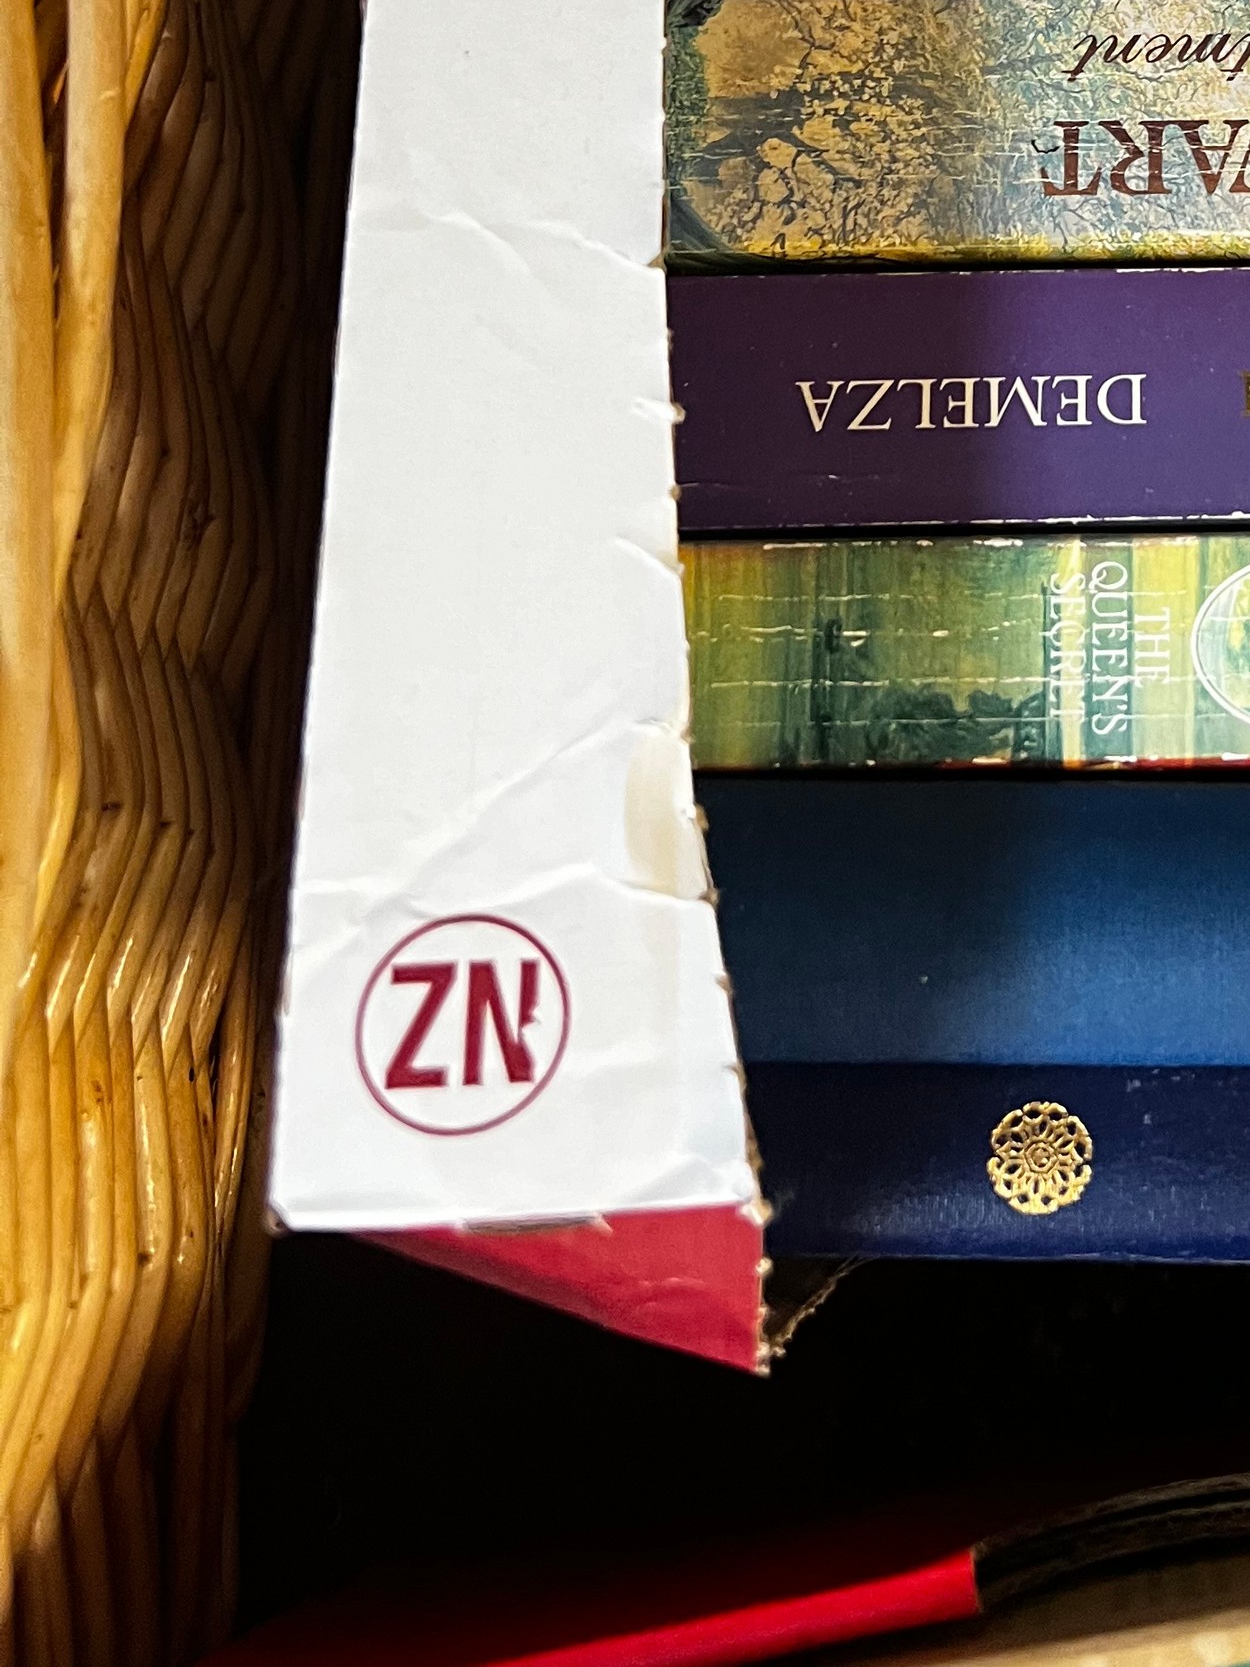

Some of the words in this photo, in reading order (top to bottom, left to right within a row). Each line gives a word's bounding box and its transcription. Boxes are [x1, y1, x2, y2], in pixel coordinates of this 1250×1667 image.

[794, 372, 1150, 434] DEMELZA
[1049, 572, 1088, 725] SECRET
[1088, 560, 1129, 737] QUEEN'S
[1133, 606, 1172, 689] THE
